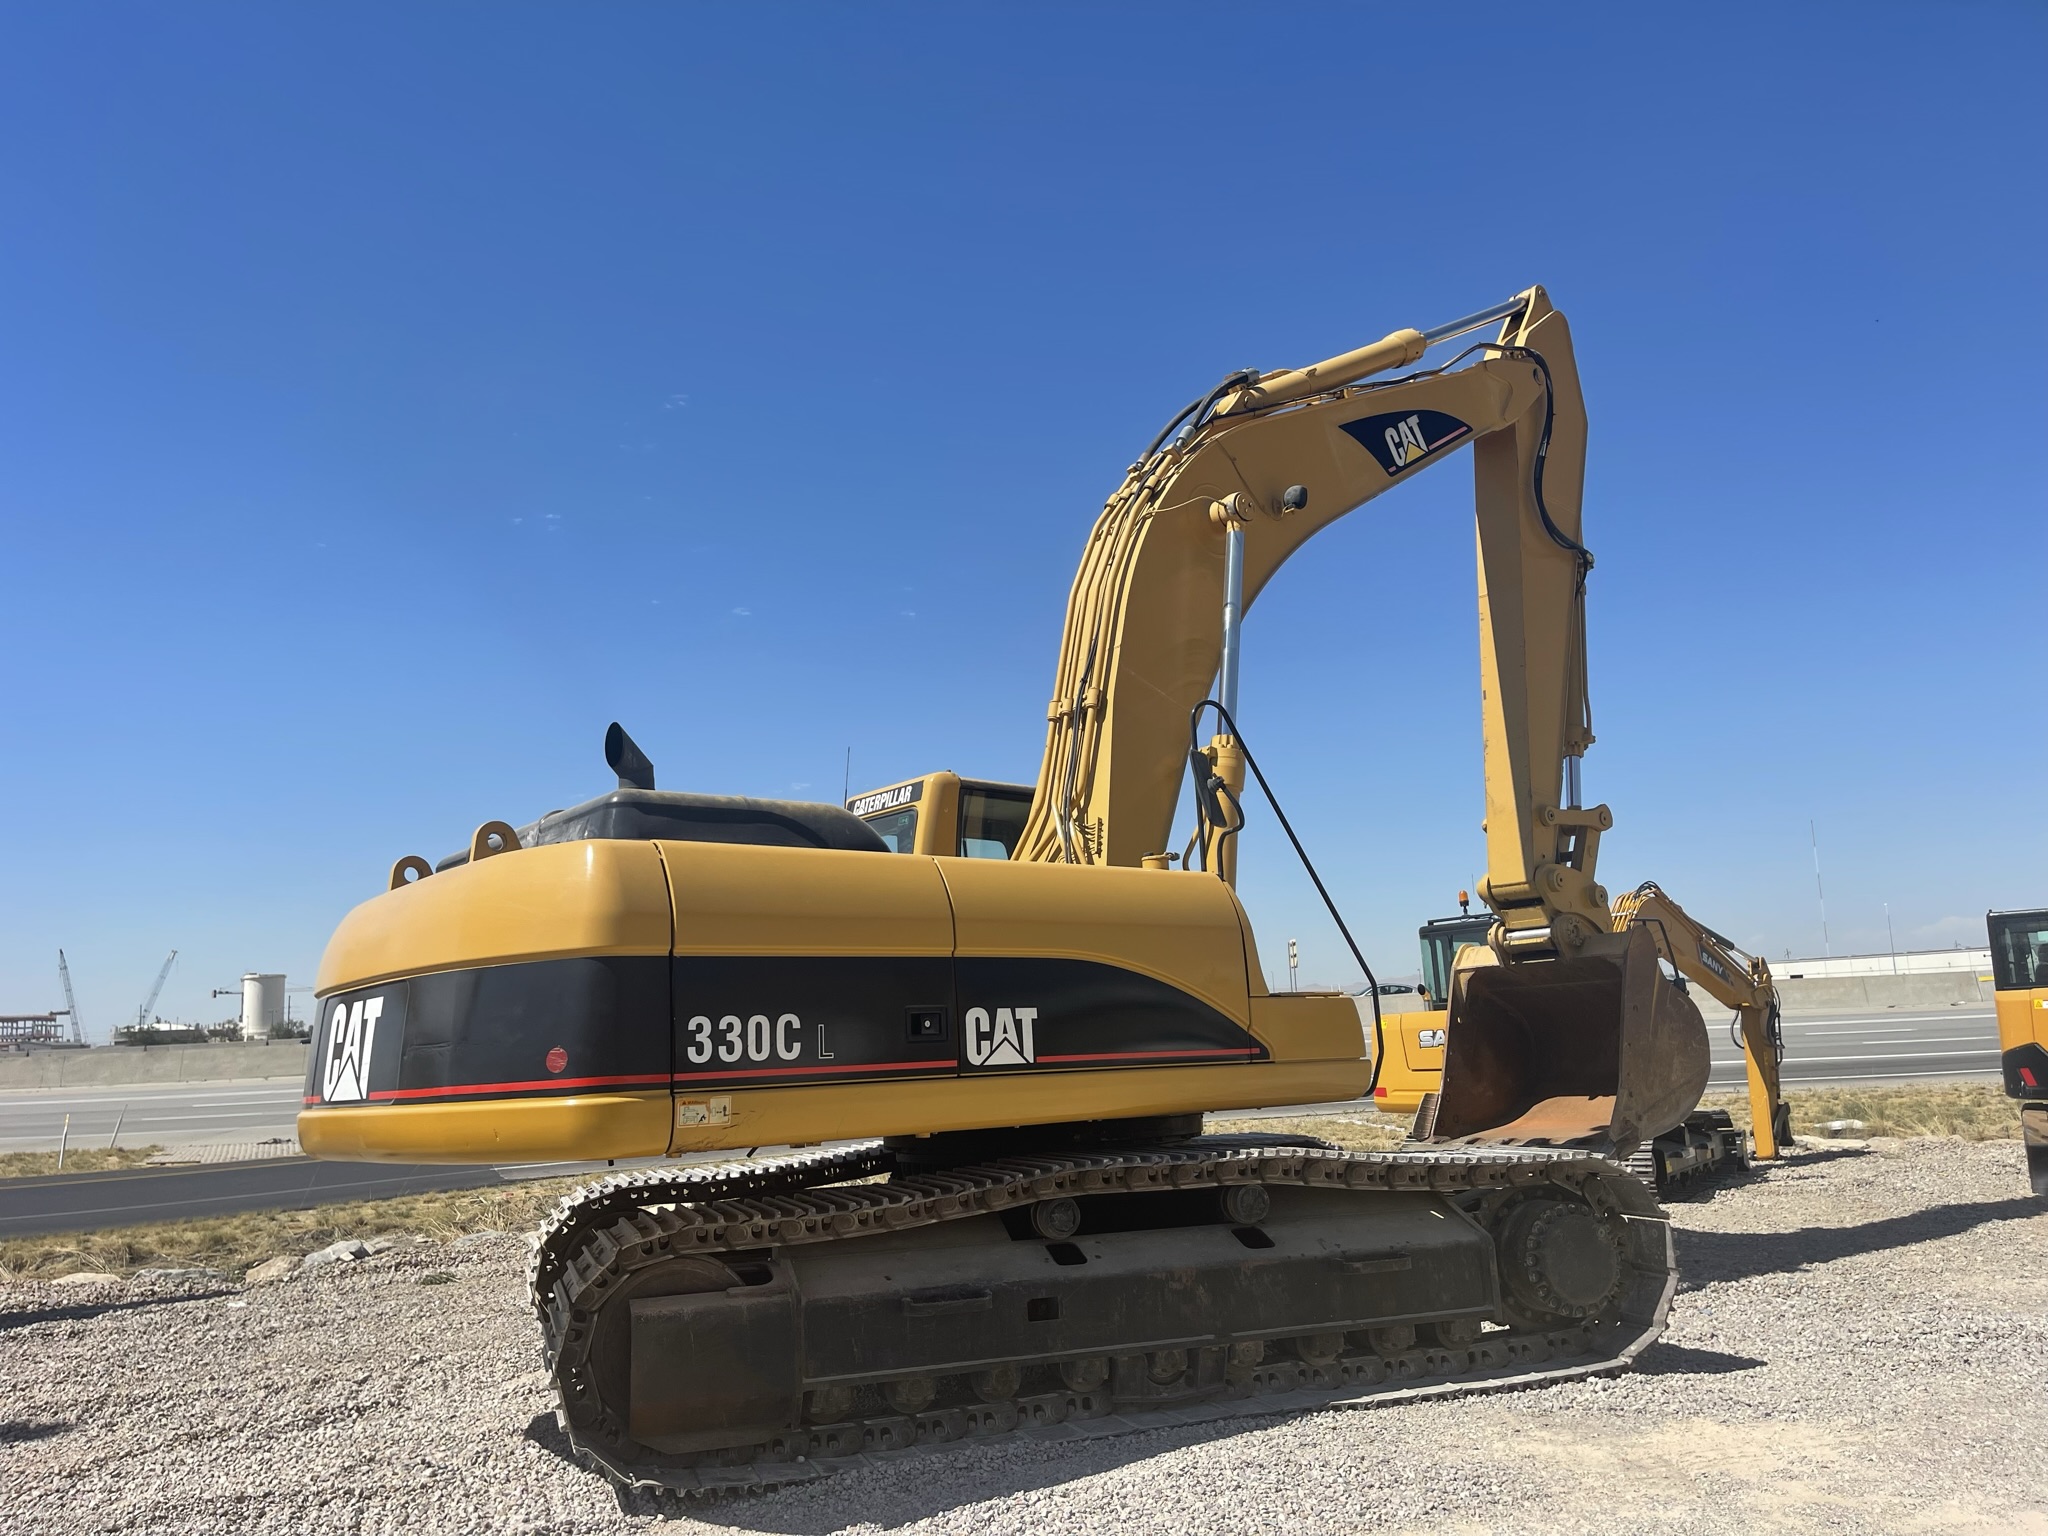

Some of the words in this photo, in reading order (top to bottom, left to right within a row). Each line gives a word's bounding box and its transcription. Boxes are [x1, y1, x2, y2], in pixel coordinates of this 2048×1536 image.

[1384, 414, 1429, 467] CAT
[853, 785, 913, 816] CATERPILLAR
[1702, 951, 1724, 975] SANY
[323, 996, 384, 1102] CAT
[687, 1013, 802, 1064] 330C
[818, 1023, 835, 1059] L
[965, 1007, 1038, 1066] CAT
